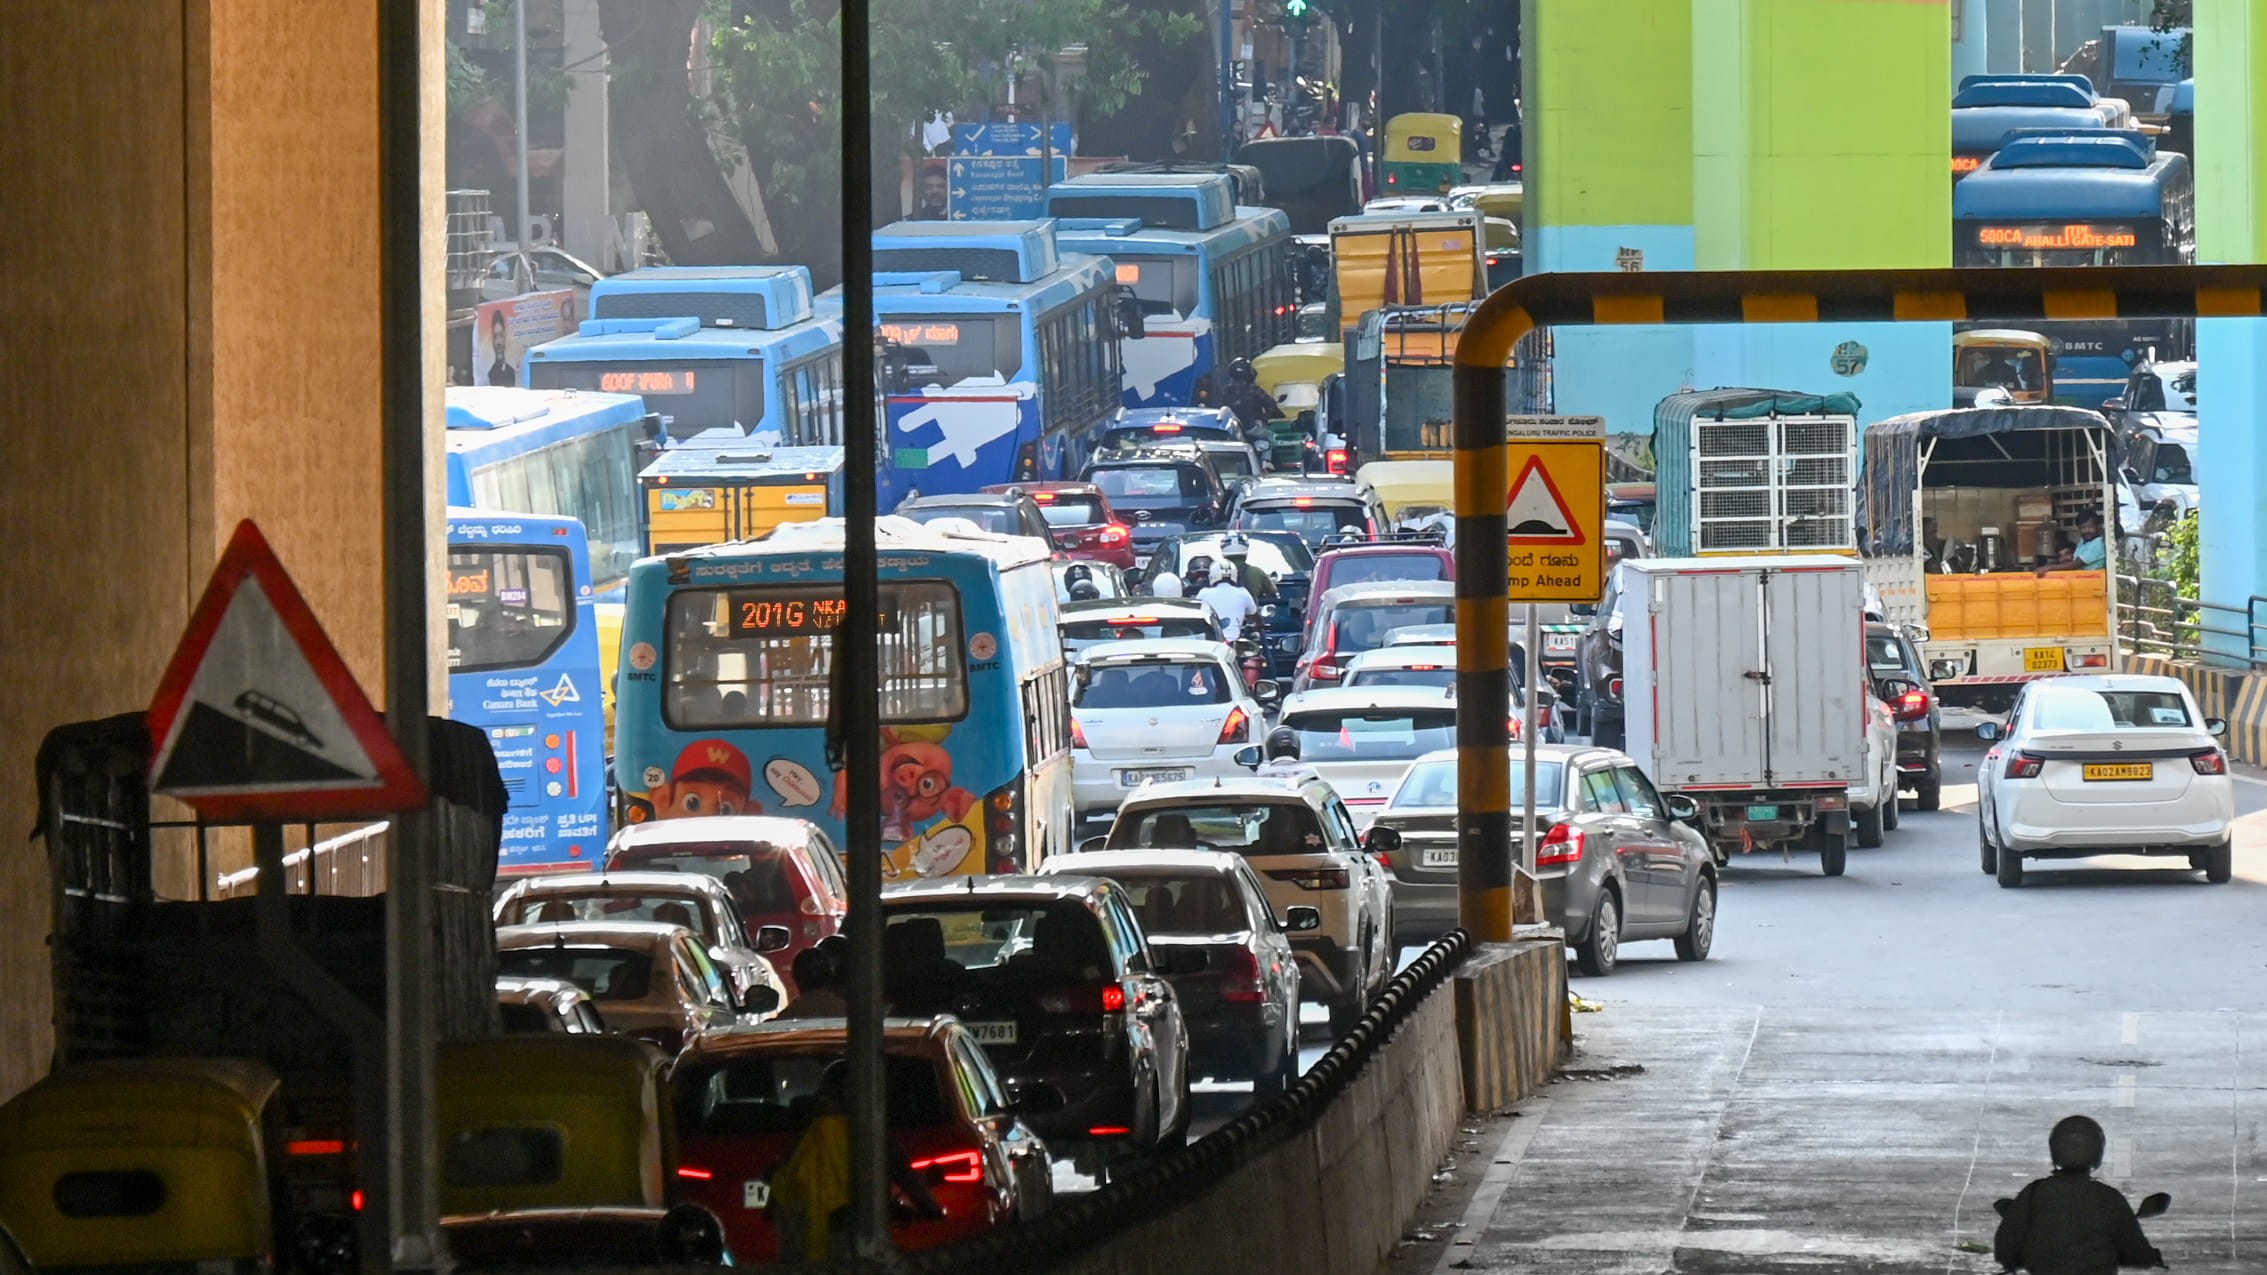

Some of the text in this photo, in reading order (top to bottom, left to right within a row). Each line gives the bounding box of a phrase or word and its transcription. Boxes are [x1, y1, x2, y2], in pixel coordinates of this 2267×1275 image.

[2064, 342, 2104, 350] BMTC
[1837, 358, 1858, 375] 57
[1536, 574, 1581, 587] Ahead
[741, 601, 805, 628] 201G
[627, 672, 657, 682] BMTC
[707, 747, 731, 764] W
[578, 814, 597, 824] UPI
